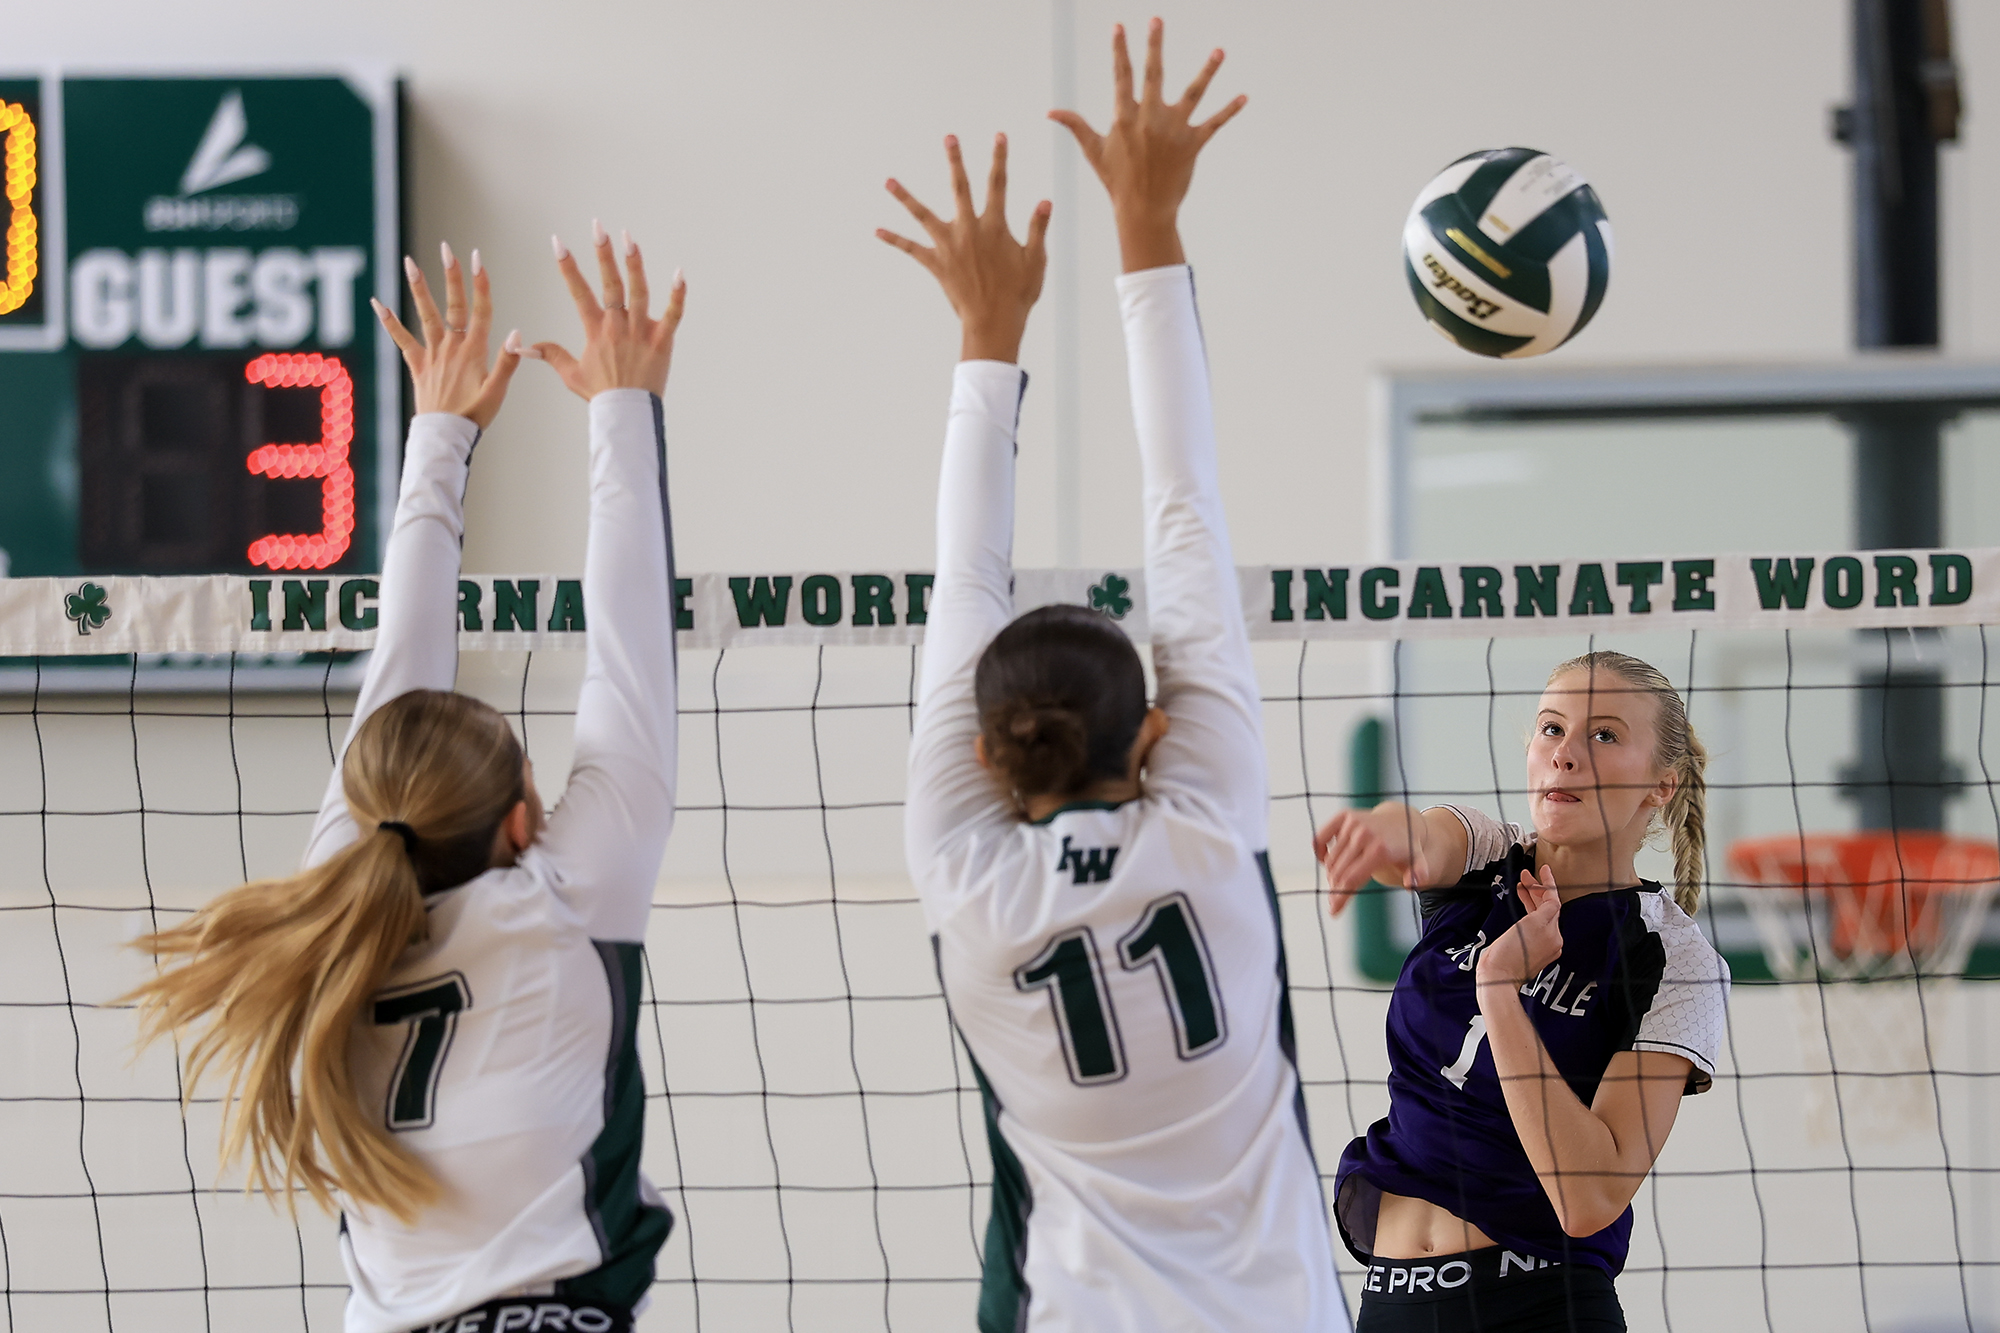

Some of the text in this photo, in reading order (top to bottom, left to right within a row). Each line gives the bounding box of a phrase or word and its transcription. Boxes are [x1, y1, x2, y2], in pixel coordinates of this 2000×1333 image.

[70, 246, 366, 350] GUEST
[1423, 254, 1502, 319] Baden
[245, 353, 354, 570] 3
[1270, 554, 1973, 622] INCARNATE WORD
[1013, 890, 1228, 1087] 11
[370, 970, 472, 1132] 7
[492, 1303, 613, 1333] PRO
[1388, 1260, 1473, 1294] PRO
